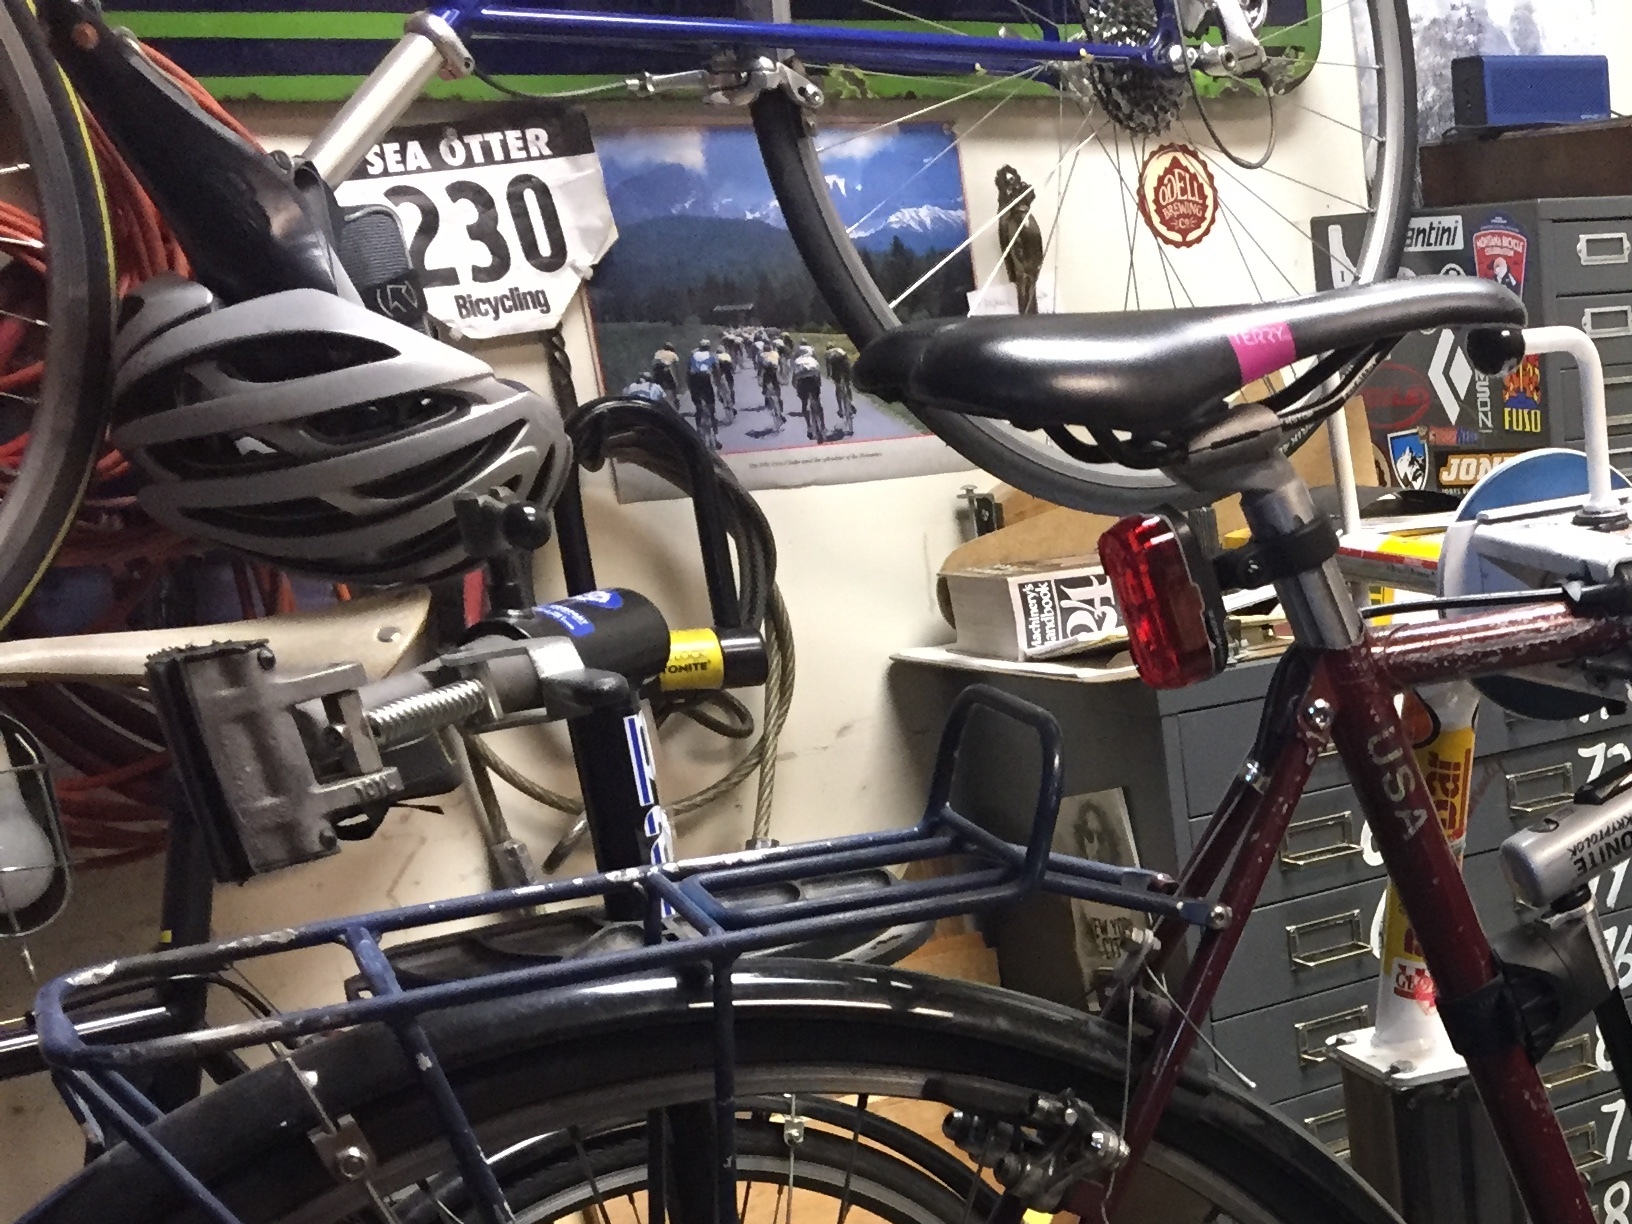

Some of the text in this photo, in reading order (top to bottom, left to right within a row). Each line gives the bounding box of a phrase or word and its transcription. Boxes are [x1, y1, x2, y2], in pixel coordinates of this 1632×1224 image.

[364, 127, 553, 175] SEA OTTER
[1159, 168, 1203, 206] ODELL
[1162, 201, 1203, 220] BREWING
[383, 173, 568, 289] 230
[1404, 219, 1460, 249] antini
[454, 286, 552, 322] Bicycling
[1228, 325, 1285, 346] TERRY
[1441, 457, 1518, 483] JON
[662, 660, 710, 675] TONITE
[1366, 734, 1429, 841] USA
